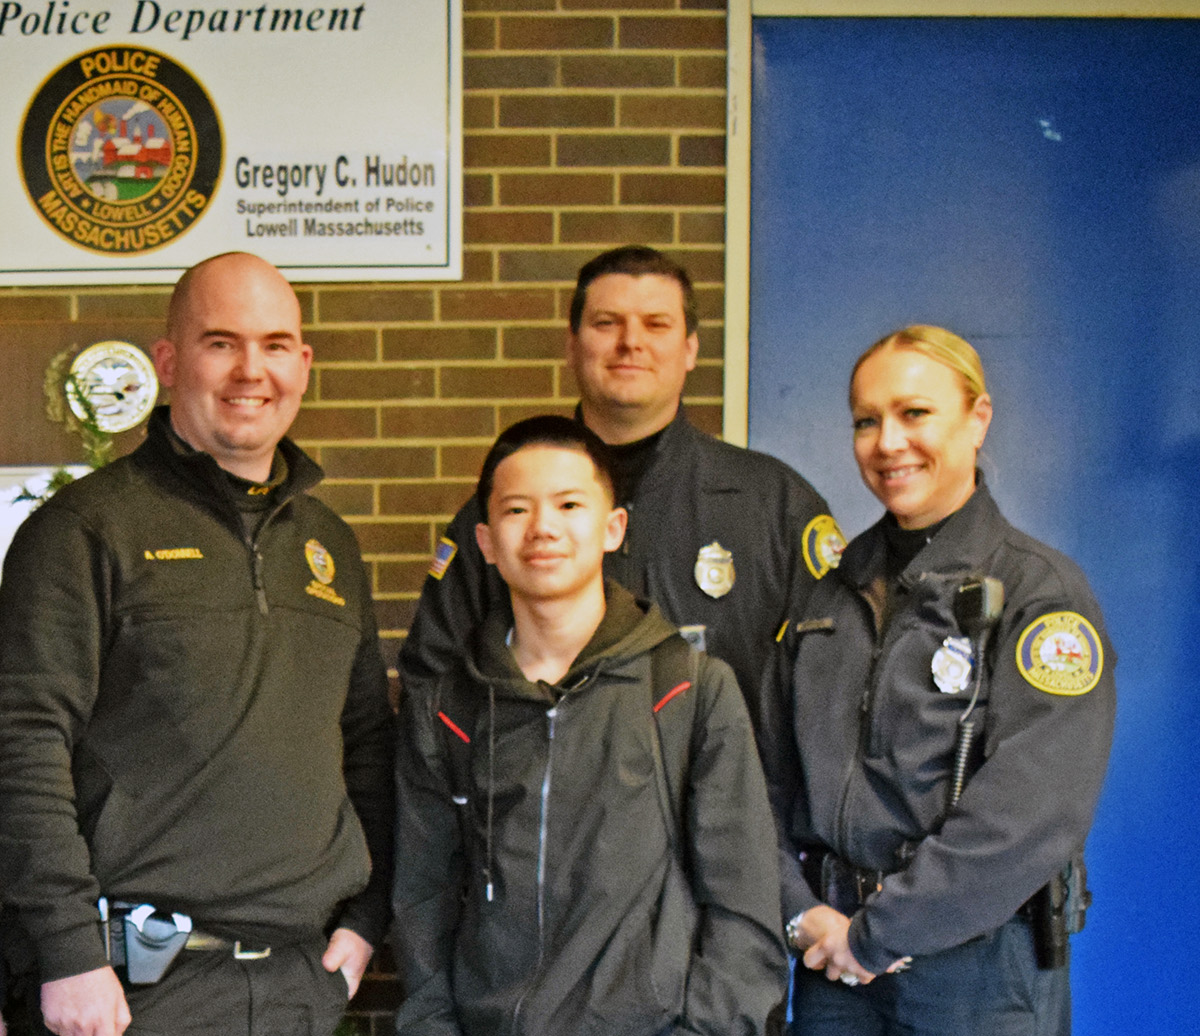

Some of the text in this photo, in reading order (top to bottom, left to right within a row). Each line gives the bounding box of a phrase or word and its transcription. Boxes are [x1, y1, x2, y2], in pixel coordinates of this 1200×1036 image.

[129, 0, 366, 41] Department
[80, 51, 161, 79] POLICE
[62, 80, 138, 122] HANDMAID
[139, 84, 162, 103] OF
[53, 121, 70, 153] THE
[156, 97, 189, 153] HUMAN
[160, 154, 190, 199] GOOD
[235, 155, 436, 197] Gregory C. Hudon
[38, 189, 207, 250] MASSACHUSETTS
[91, 203, 151, 222] LOWELL
[236, 197, 435, 218] Superintendent of Police
[246, 217, 426, 238] Lowell Massachusetts
